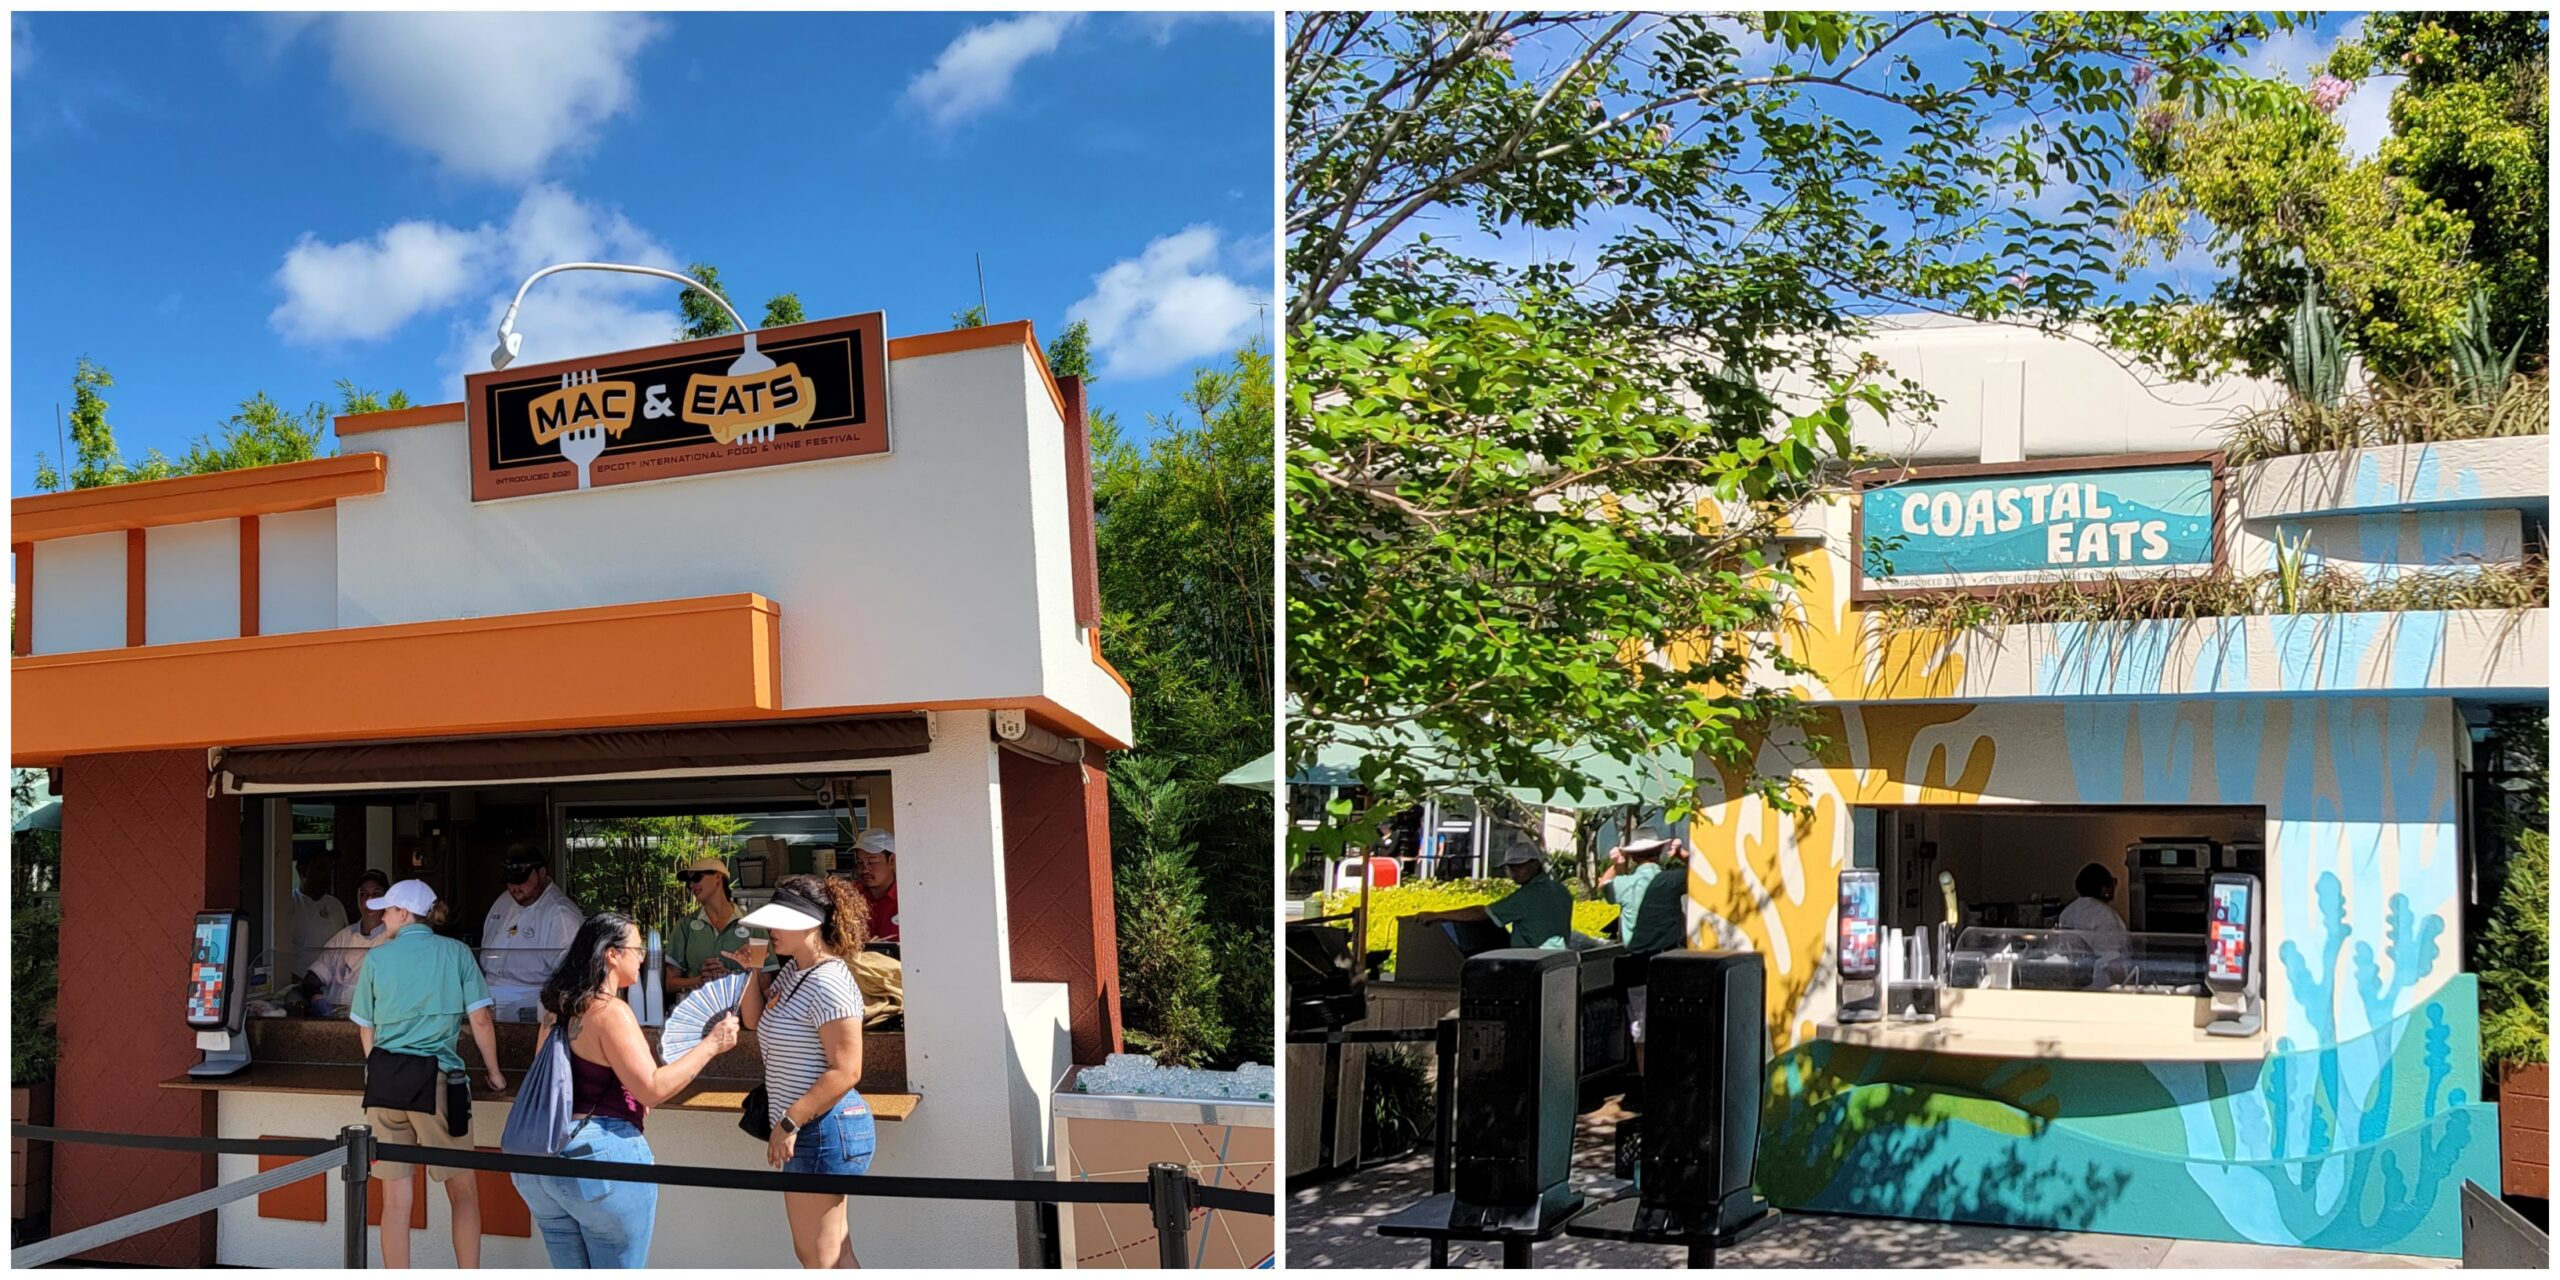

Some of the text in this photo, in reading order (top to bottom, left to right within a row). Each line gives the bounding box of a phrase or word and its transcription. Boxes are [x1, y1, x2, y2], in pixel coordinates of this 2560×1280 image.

[534, 373, 800, 436] MAC & EATS
[639, 451, 724, 468] INTERNATIONAL
[727, 445, 758, 457] FOOD
[773, 440, 801, 451] WINE
[805, 432, 861, 447] FESTIVAL
[496, 470, 572, 486] INTRODUCED 2021
[1902, 482, 2112, 537] COASTAL
[2047, 520, 2170, 564] EATS
